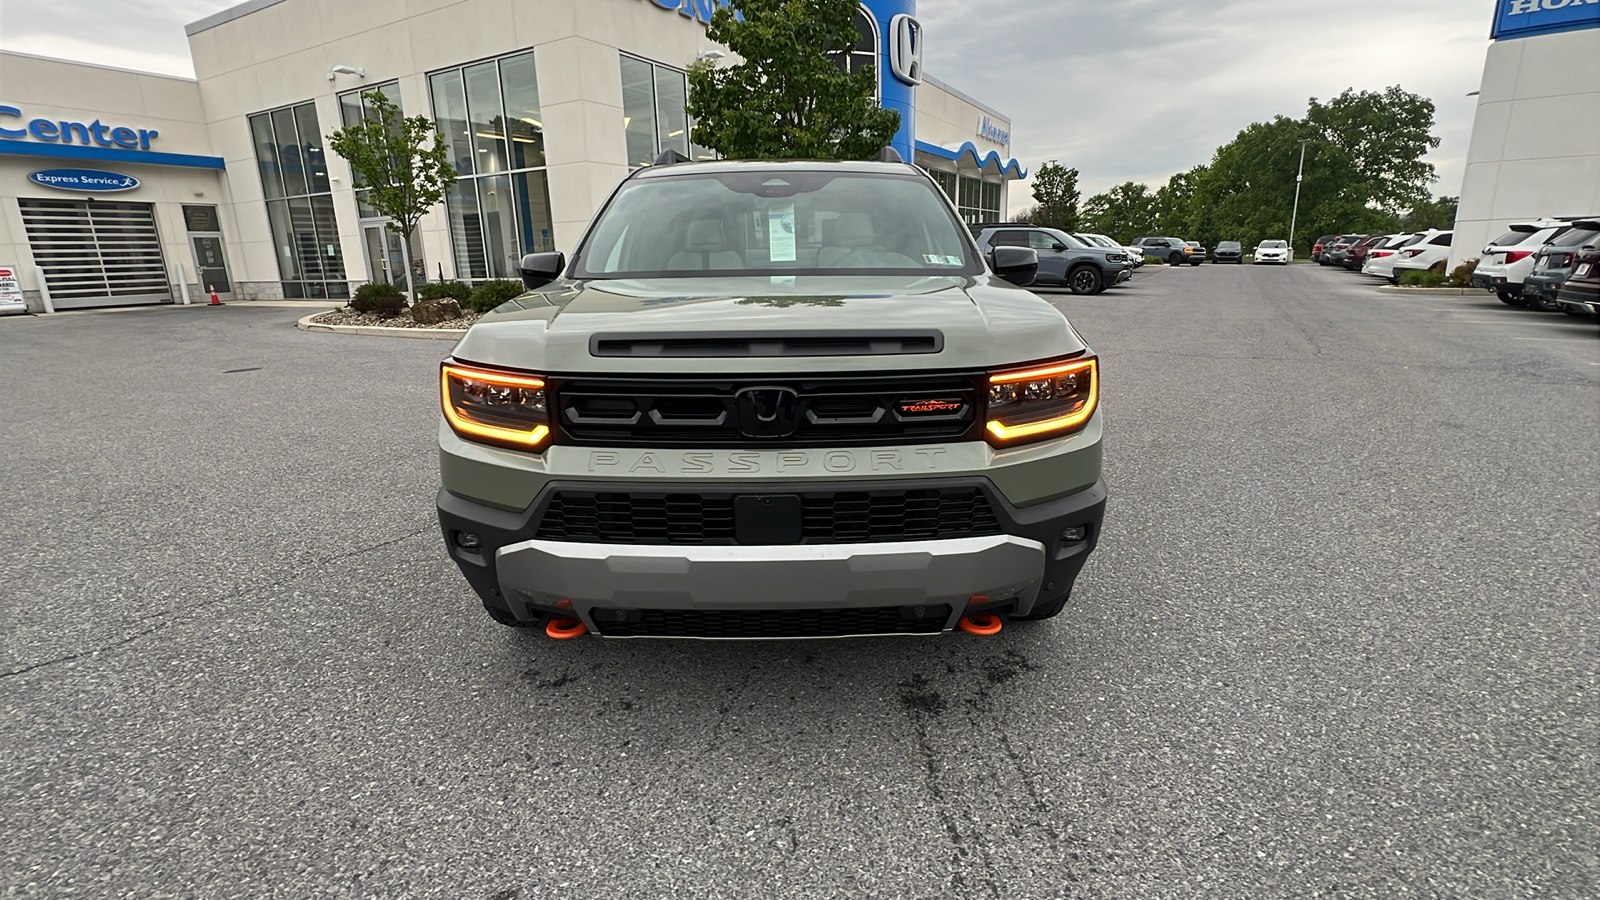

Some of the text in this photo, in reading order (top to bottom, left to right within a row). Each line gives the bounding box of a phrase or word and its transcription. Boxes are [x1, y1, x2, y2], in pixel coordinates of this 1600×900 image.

[0, 105, 158, 149] Center
[36, 173, 119, 185] Express Service
[901, 403, 961, 412] TRAILSPORT
[587, 447, 947, 474] PASSPORT
